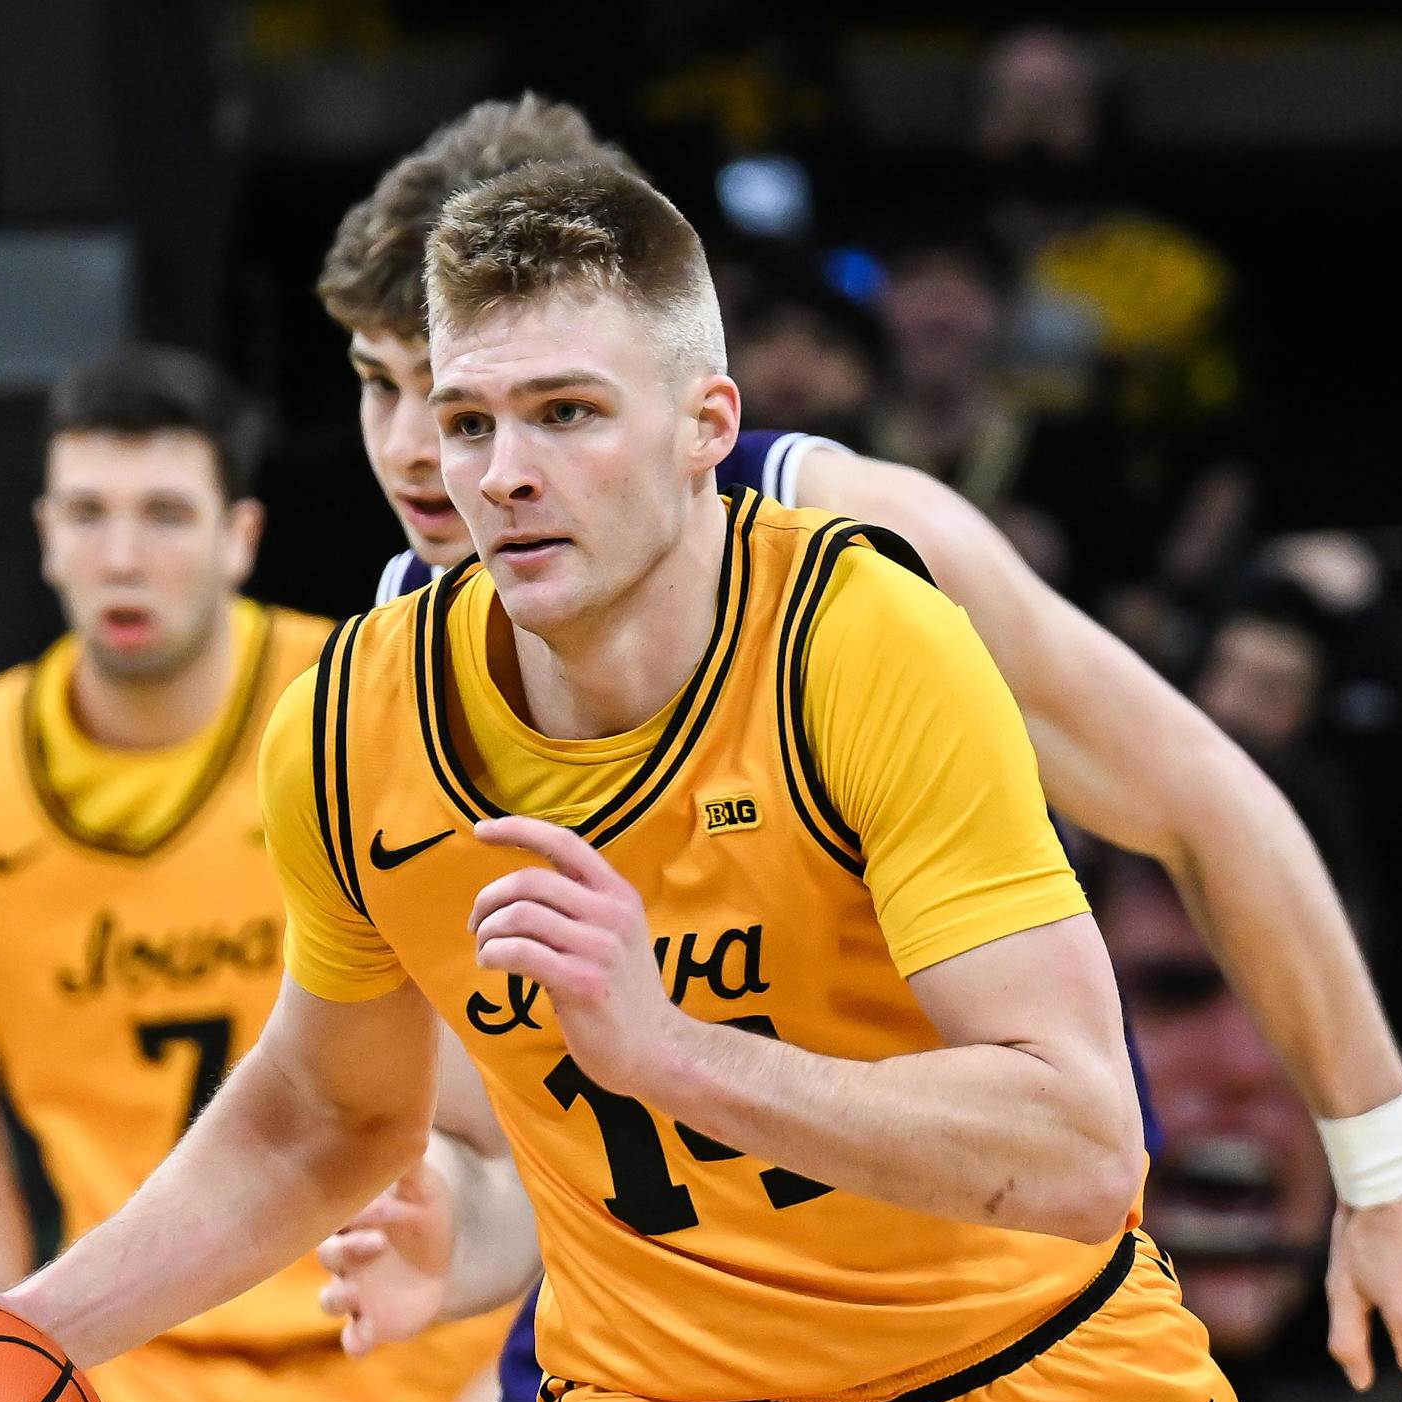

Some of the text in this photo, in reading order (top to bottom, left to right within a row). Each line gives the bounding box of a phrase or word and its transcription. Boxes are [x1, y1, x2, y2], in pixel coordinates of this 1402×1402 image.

[466, 924, 770, 1035] Iwa
[135, 1014, 236, 1132] 7
[543, 1014, 838, 1236] 1
